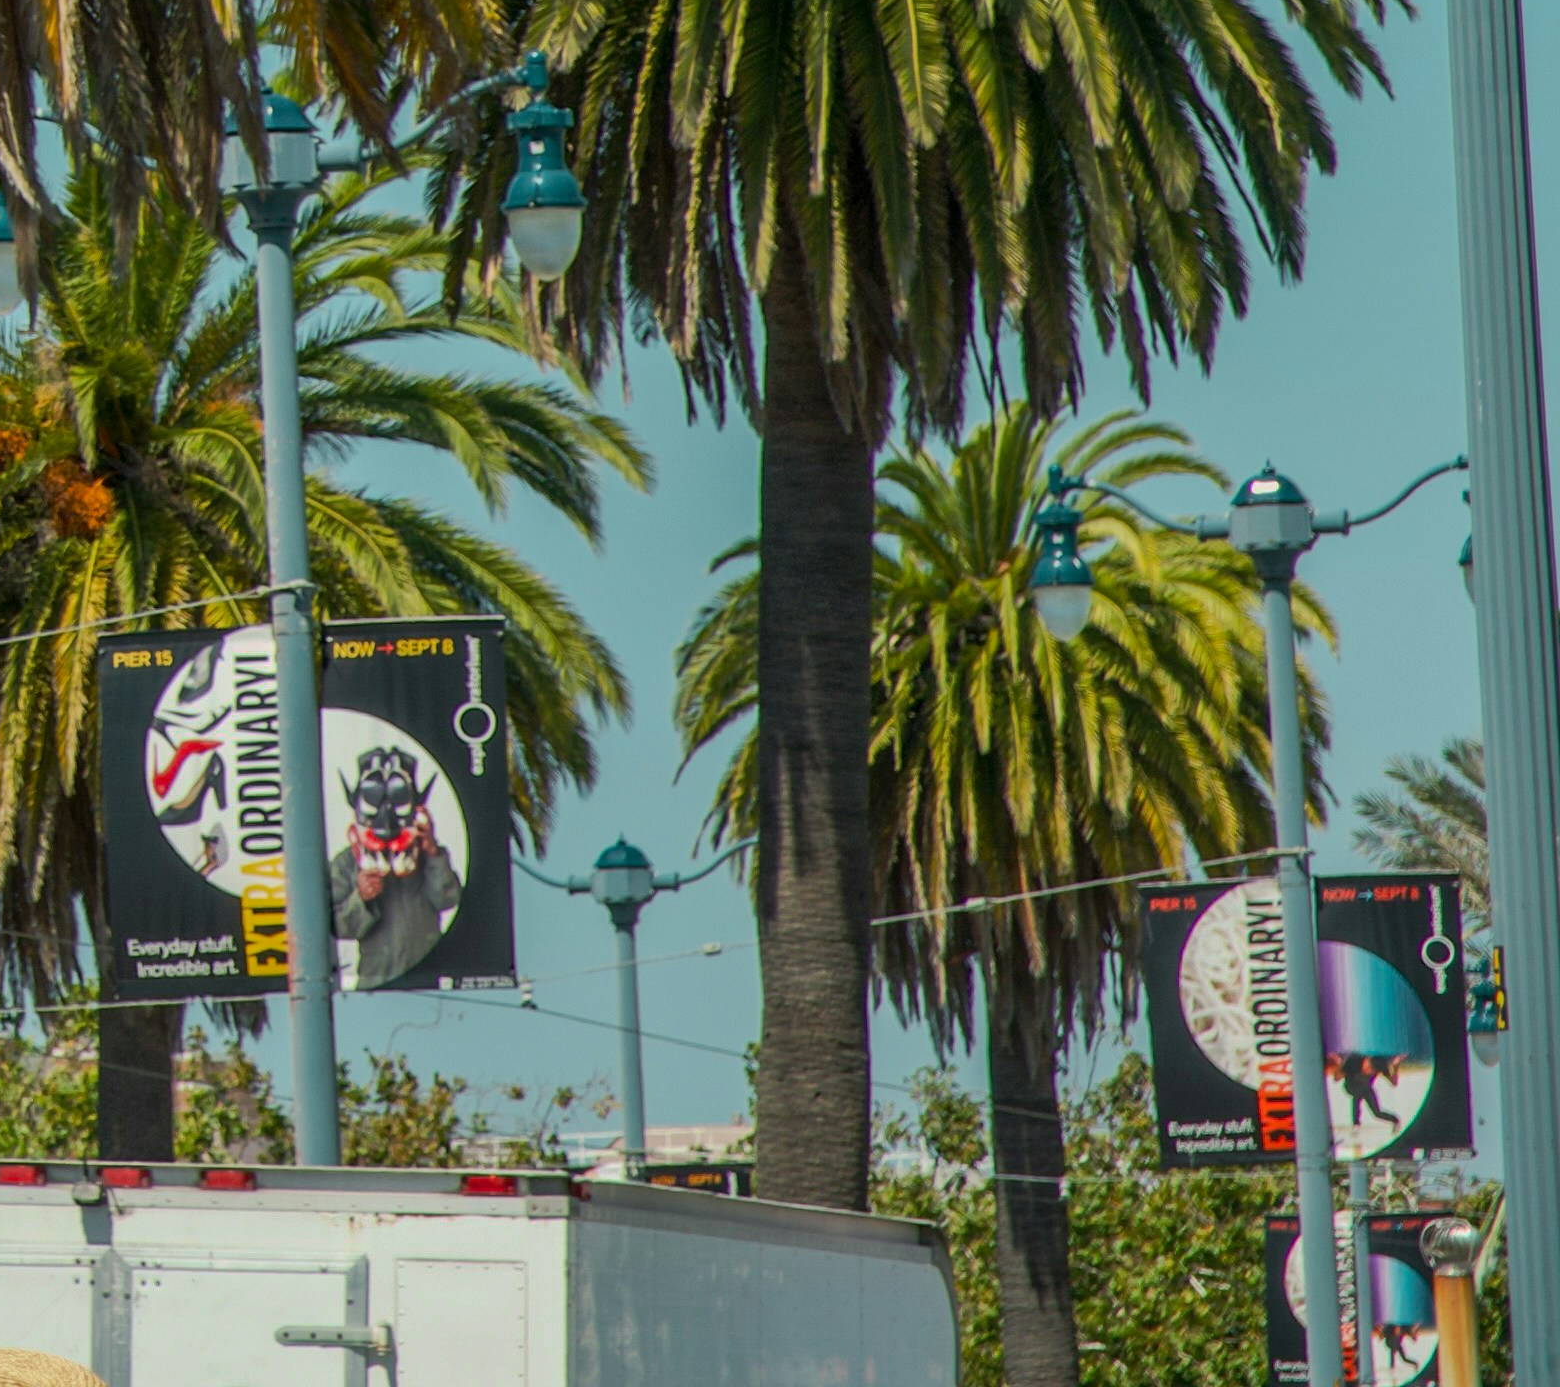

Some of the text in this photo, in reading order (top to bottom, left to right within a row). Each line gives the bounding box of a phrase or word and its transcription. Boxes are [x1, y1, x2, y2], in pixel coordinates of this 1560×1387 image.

[333, 637, 454, 658] NOW SEPT 8
[113, 650, 173, 668] PIER 15
[126, 937, 197, 959] Everyday
[137, 959, 211, 978] Incredible
